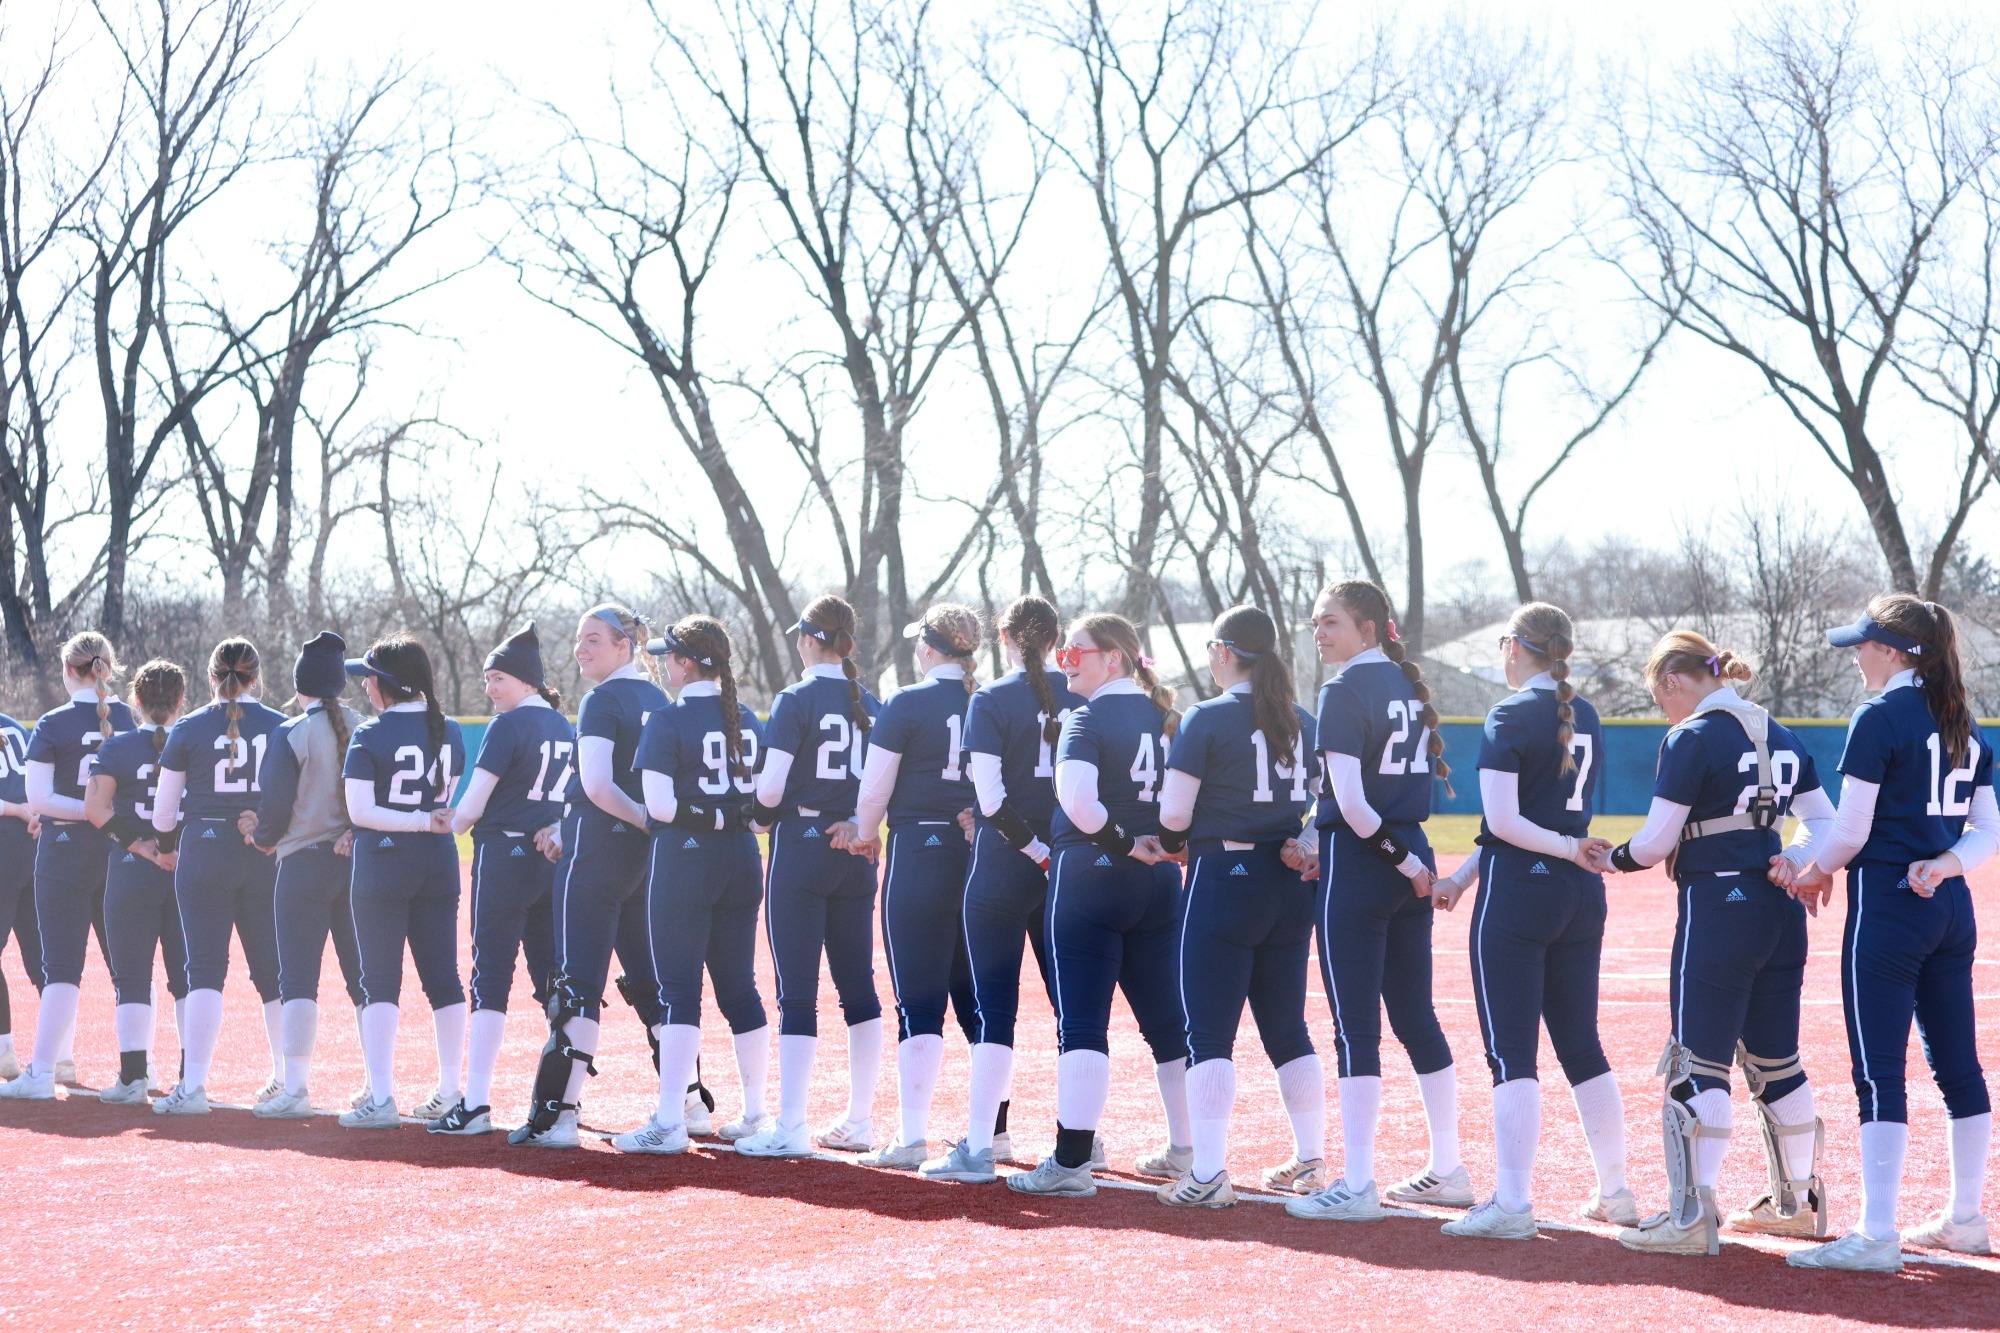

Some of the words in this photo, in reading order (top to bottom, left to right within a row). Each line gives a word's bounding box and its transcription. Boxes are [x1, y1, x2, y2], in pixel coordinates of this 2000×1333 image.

[77, 731, 129, 785] 2
[214, 734, 268, 792] 21
[527, 740, 573, 802] 17
[941, 714, 976, 781] 1
[1034, 707, 1071, 778] 1
[1251, 729, 1307, 802] 14
[1379, 700, 1430, 774] 27
[135, 764, 187, 821] 3
[388, 744, 451, 804] 24
[1566, 733, 1593, 811] 7
[1733, 750, 1799, 829] 28
[1926, 732, 1980, 816] 12
